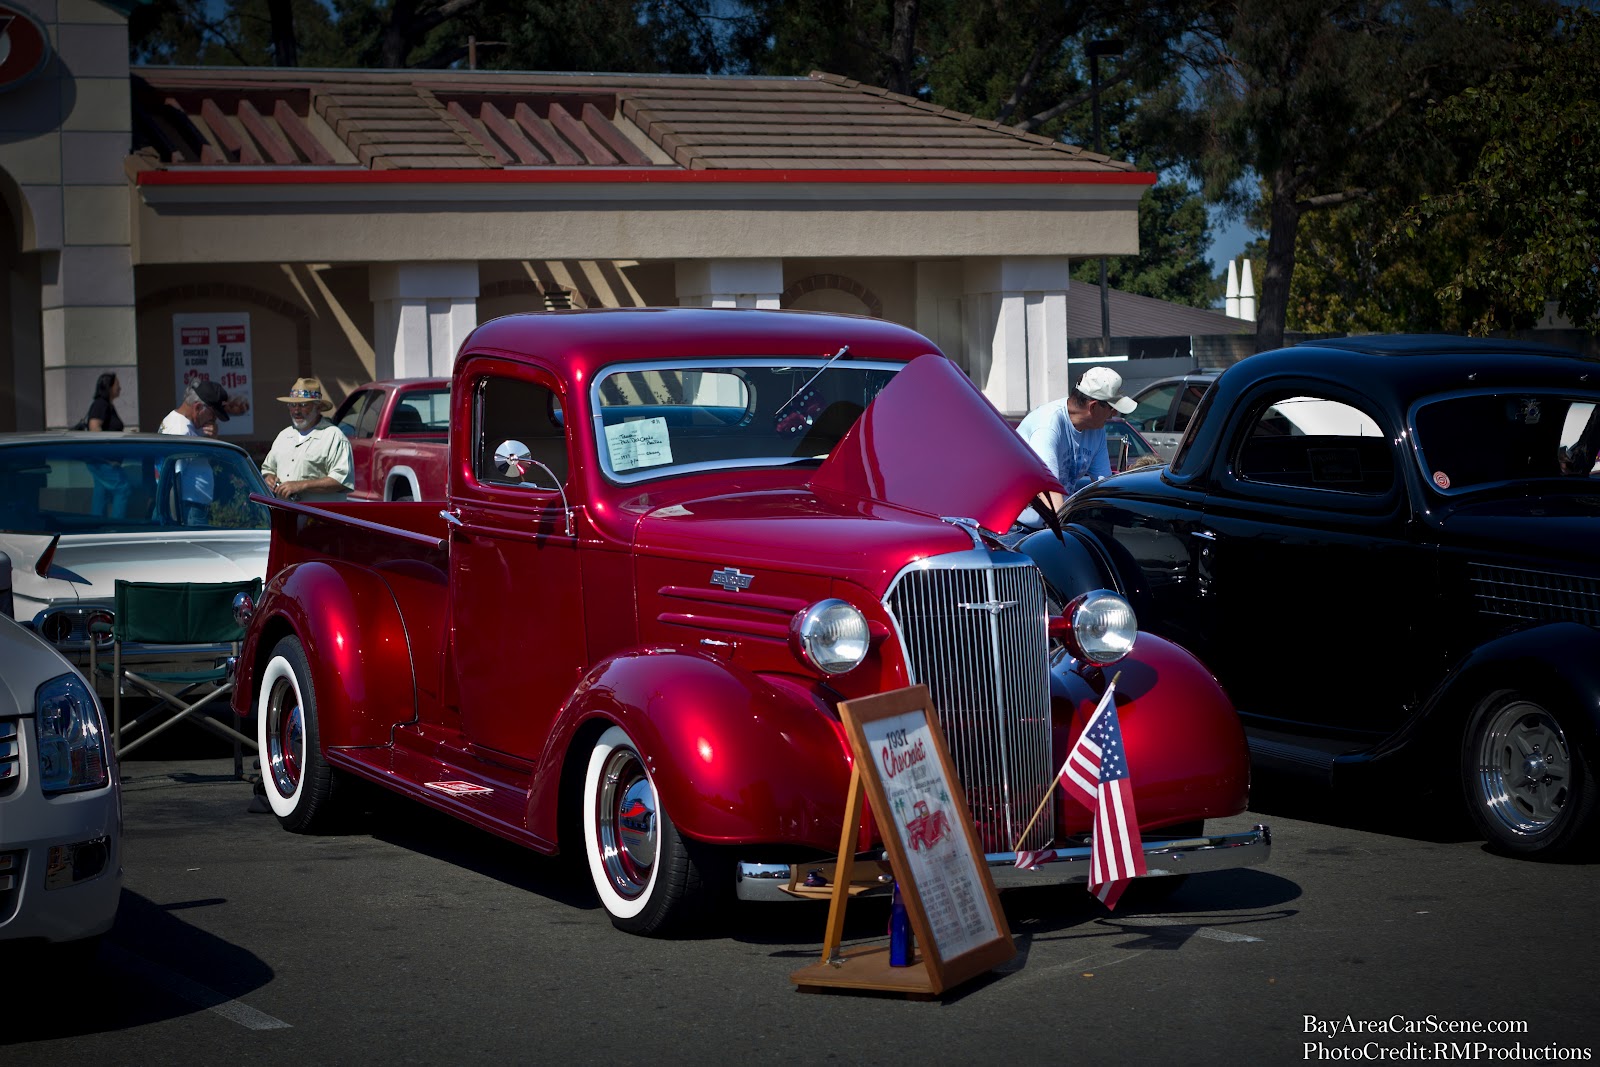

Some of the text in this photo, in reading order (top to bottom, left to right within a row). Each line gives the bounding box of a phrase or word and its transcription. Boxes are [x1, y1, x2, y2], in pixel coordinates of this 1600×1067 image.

[183, 348, 208, 356] CHICKEN
[220, 345, 227, 358] 7
[222, 357, 244, 366] MEAL
[886, 728, 908, 750] 1937
[882, 738, 926, 779] Chevrolet
